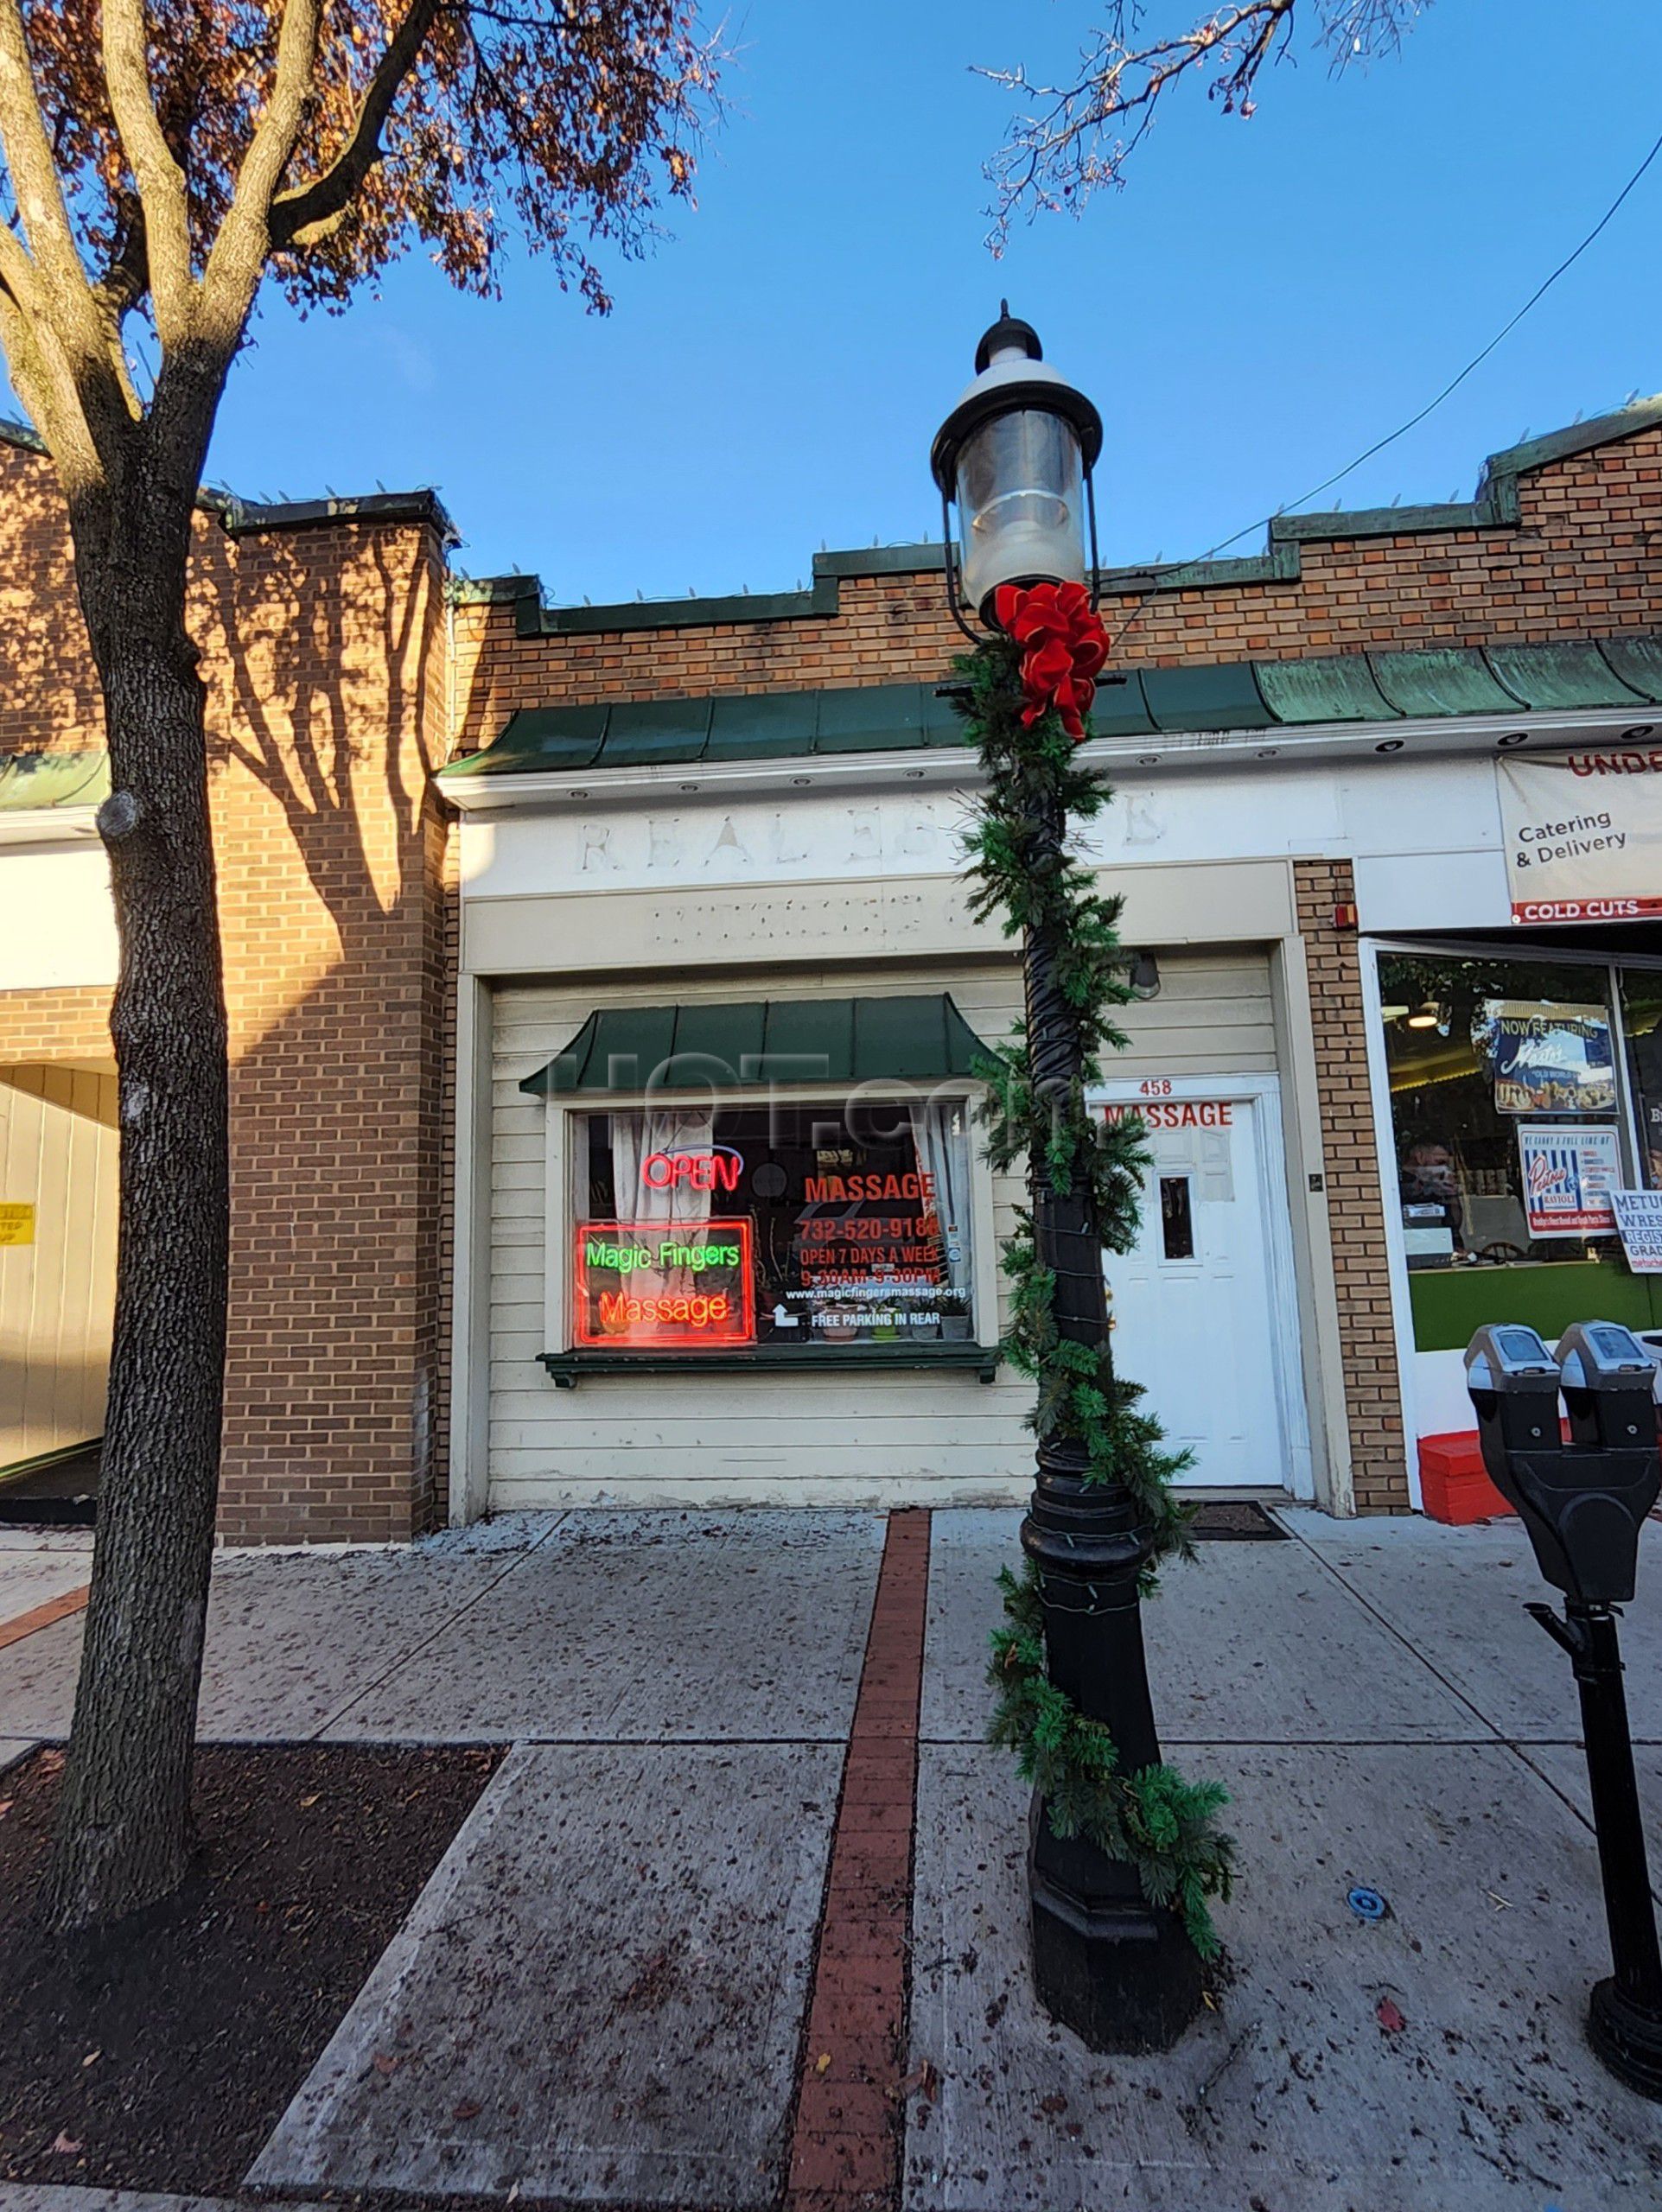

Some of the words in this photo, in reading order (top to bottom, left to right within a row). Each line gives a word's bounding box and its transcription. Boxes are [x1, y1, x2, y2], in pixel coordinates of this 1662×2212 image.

[1568, 751, 1662, 777] UNDE
[1519, 812, 1611, 842] Catering
[1517, 852, 1531, 868] &
[1538, 831, 1627, 863] Delivery
[1525, 904, 1581, 920] COLD
[1586, 900, 1640, 916] CUTS
[1501, 1020, 1529, 1036] NOW
[1139, 1080, 1173, 1096] 458
[1103, 1101, 1233, 1128] MASSAGE
[641, 1154, 740, 1192] OPEN
[804, 1173, 937, 1202] MASSAGE
[1544, 1195, 1575, 1204] RAVIOLI
[587, 1243, 653, 1274] Magic
[659, 1241, 740, 1273] Fingers
[800, 1248, 836, 1265] OPEN
[839, 1248, 846, 1264] 7
[850, 1247, 885, 1264] DAYS
[889, 1247, 899, 1262] A
[901, 1246, 939, 1262] WEEK
[786, 1287, 966, 1300] www.magicfingersmassage.org
[600, 1291, 728, 1328] Massage
[812, 1315, 840, 1328] FREE
[843, 1313, 893, 1326] PARKING
[895, 1313, 907, 1325] IN
[910, 1312, 940, 1325] REAR
